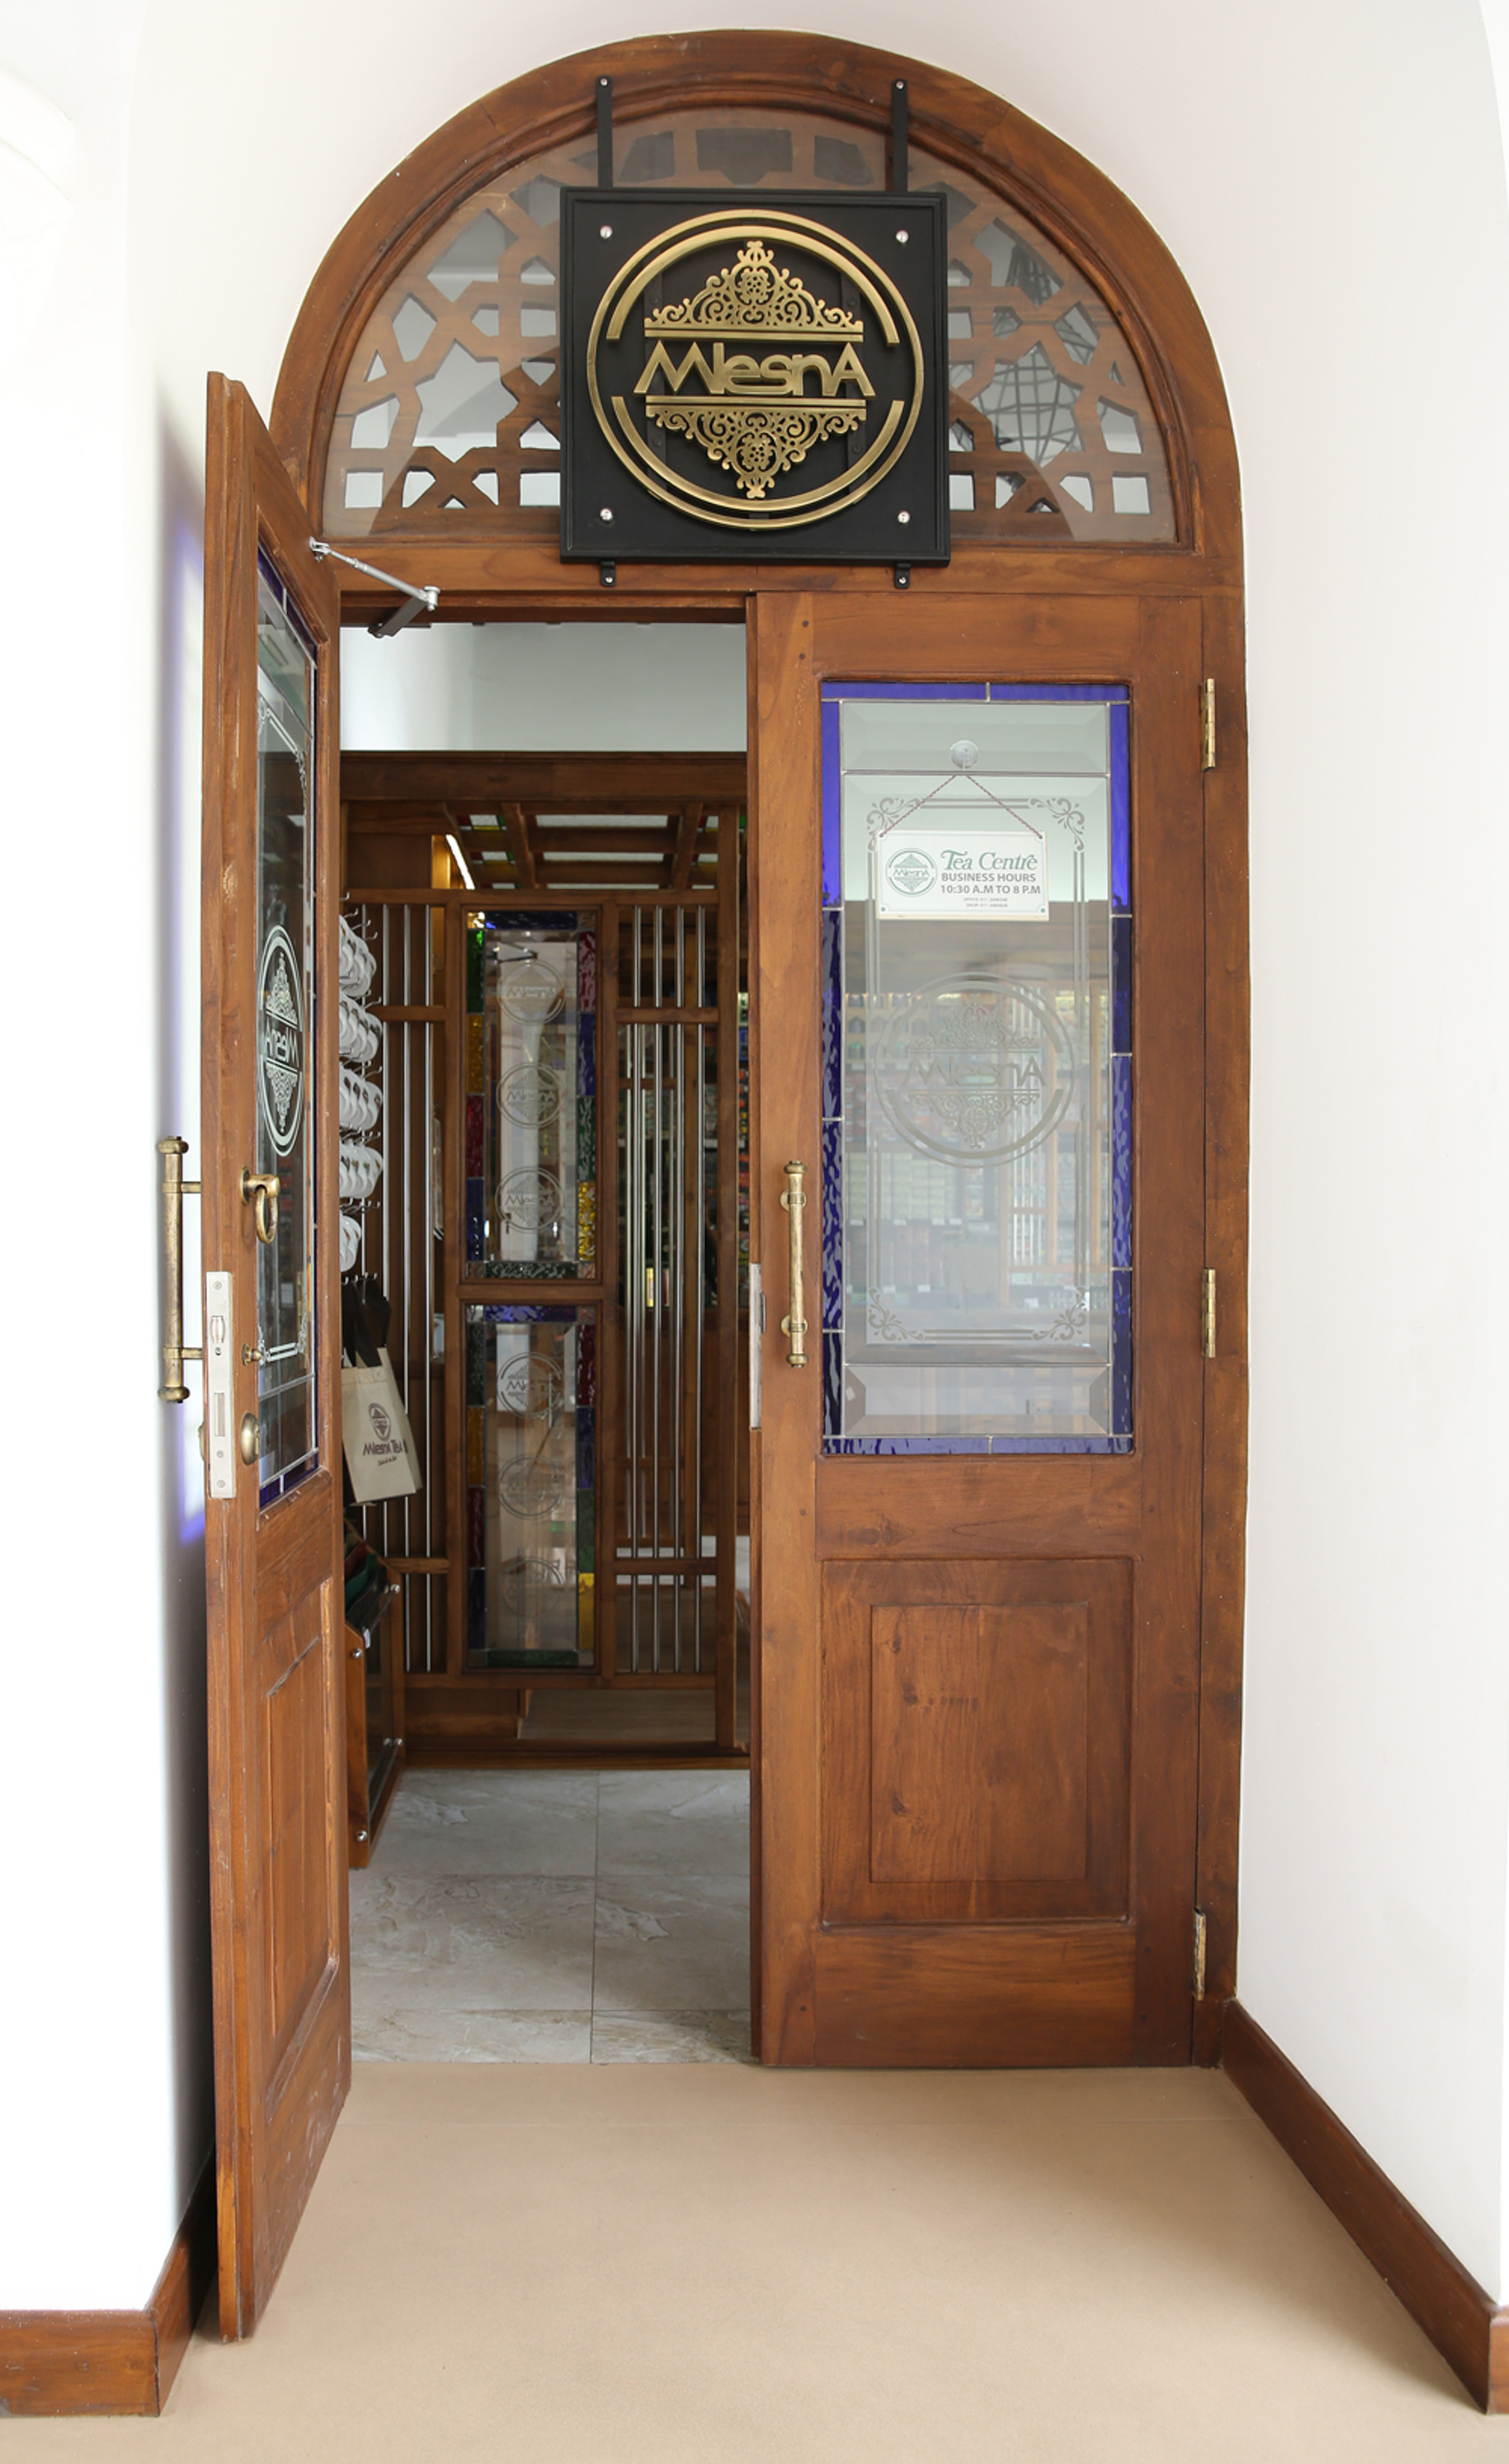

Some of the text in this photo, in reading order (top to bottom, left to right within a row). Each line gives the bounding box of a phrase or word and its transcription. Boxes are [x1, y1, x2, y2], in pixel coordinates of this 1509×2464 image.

[940, 849, 1038, 871] Tea Centre
[941, 872, 1037, 883] BUSINESS HOURS
[941, 885, 1041, 894] 10:30 A.M TO 8 P.M
